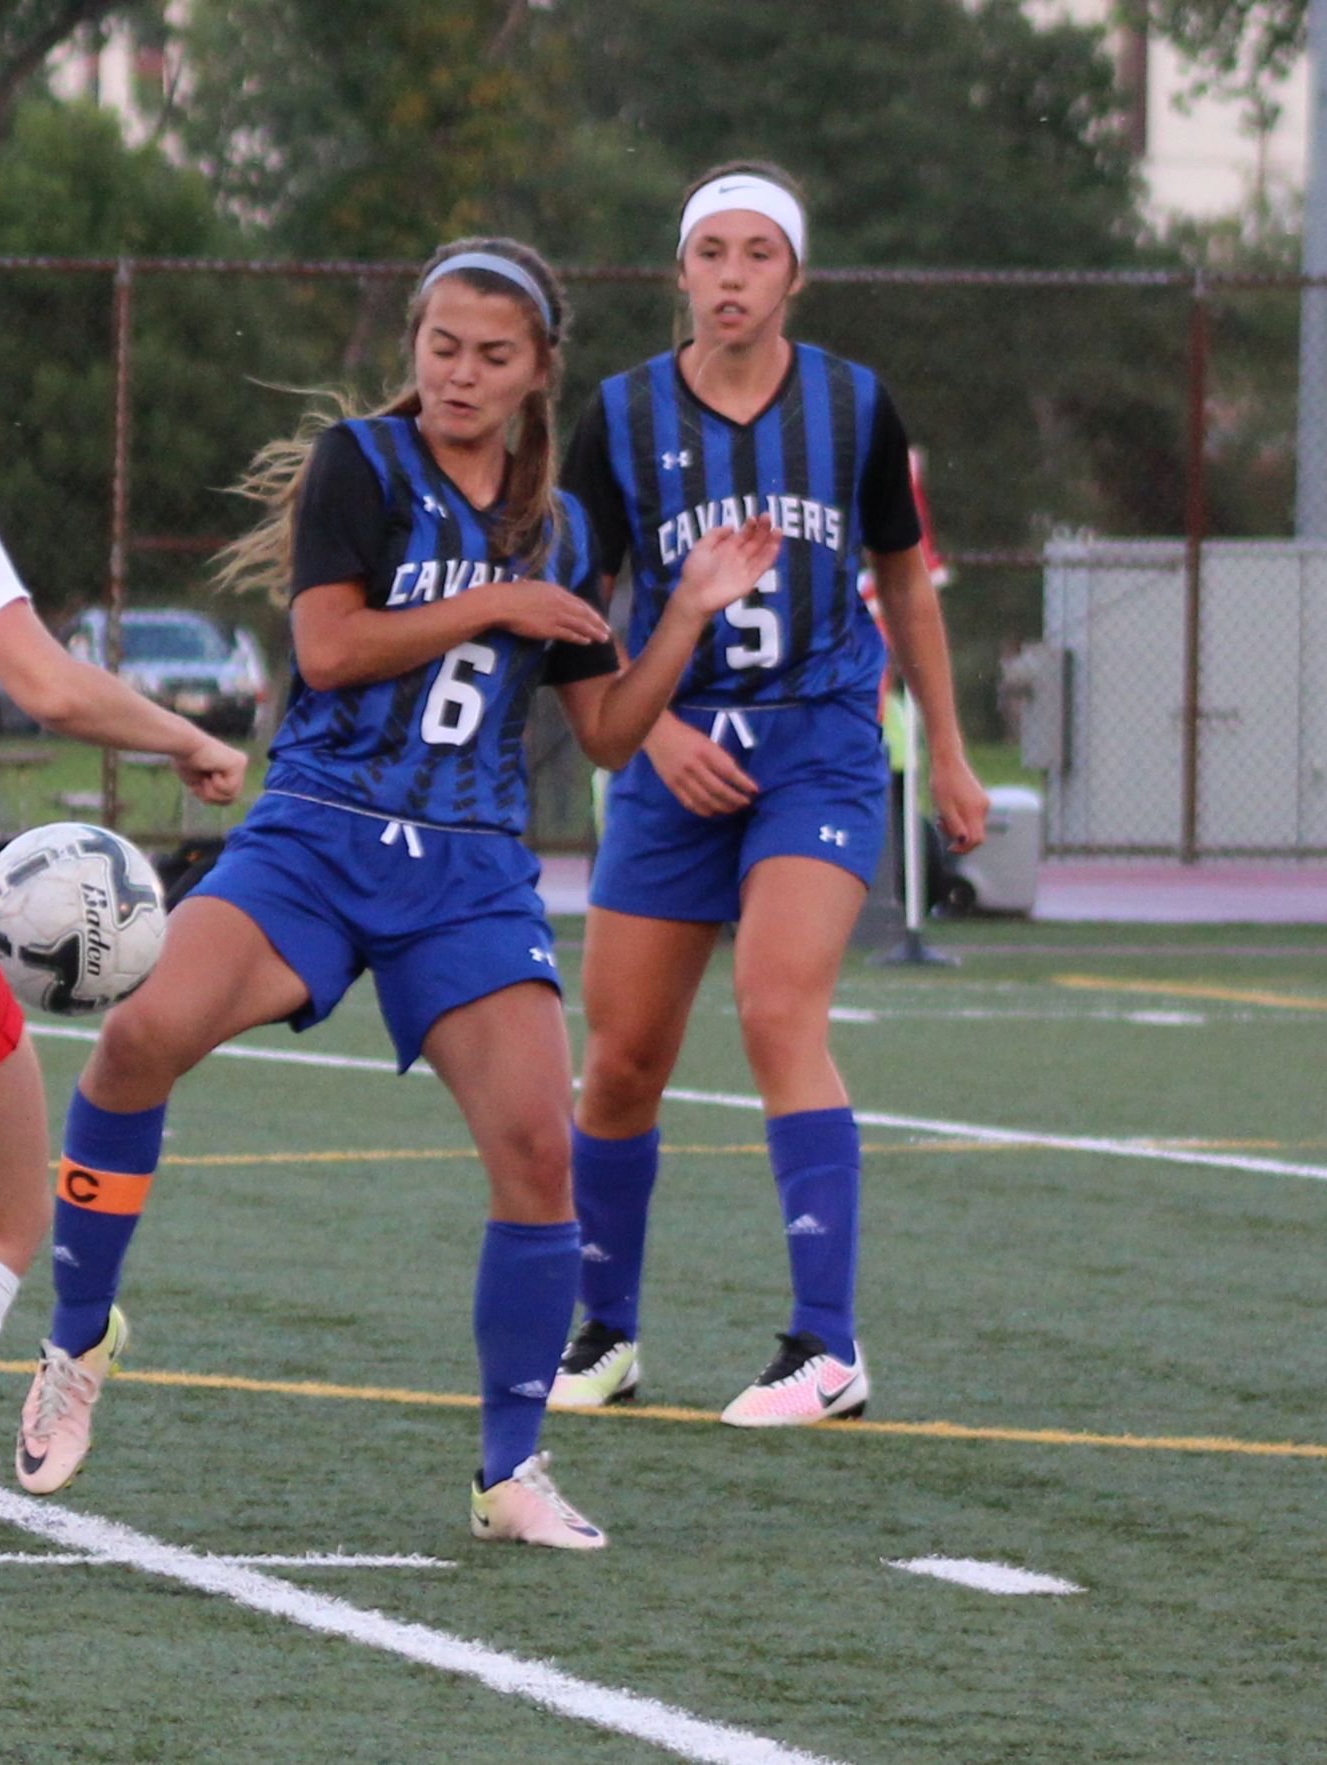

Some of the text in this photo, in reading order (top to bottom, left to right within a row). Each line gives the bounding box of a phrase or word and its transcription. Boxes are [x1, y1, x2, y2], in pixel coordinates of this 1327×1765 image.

[725, 568, 780, 670] 5
[421, 641, 495, 746] 6
[81, 883, 111, 976] Baden
[66, 1169, 99, 1203] C
